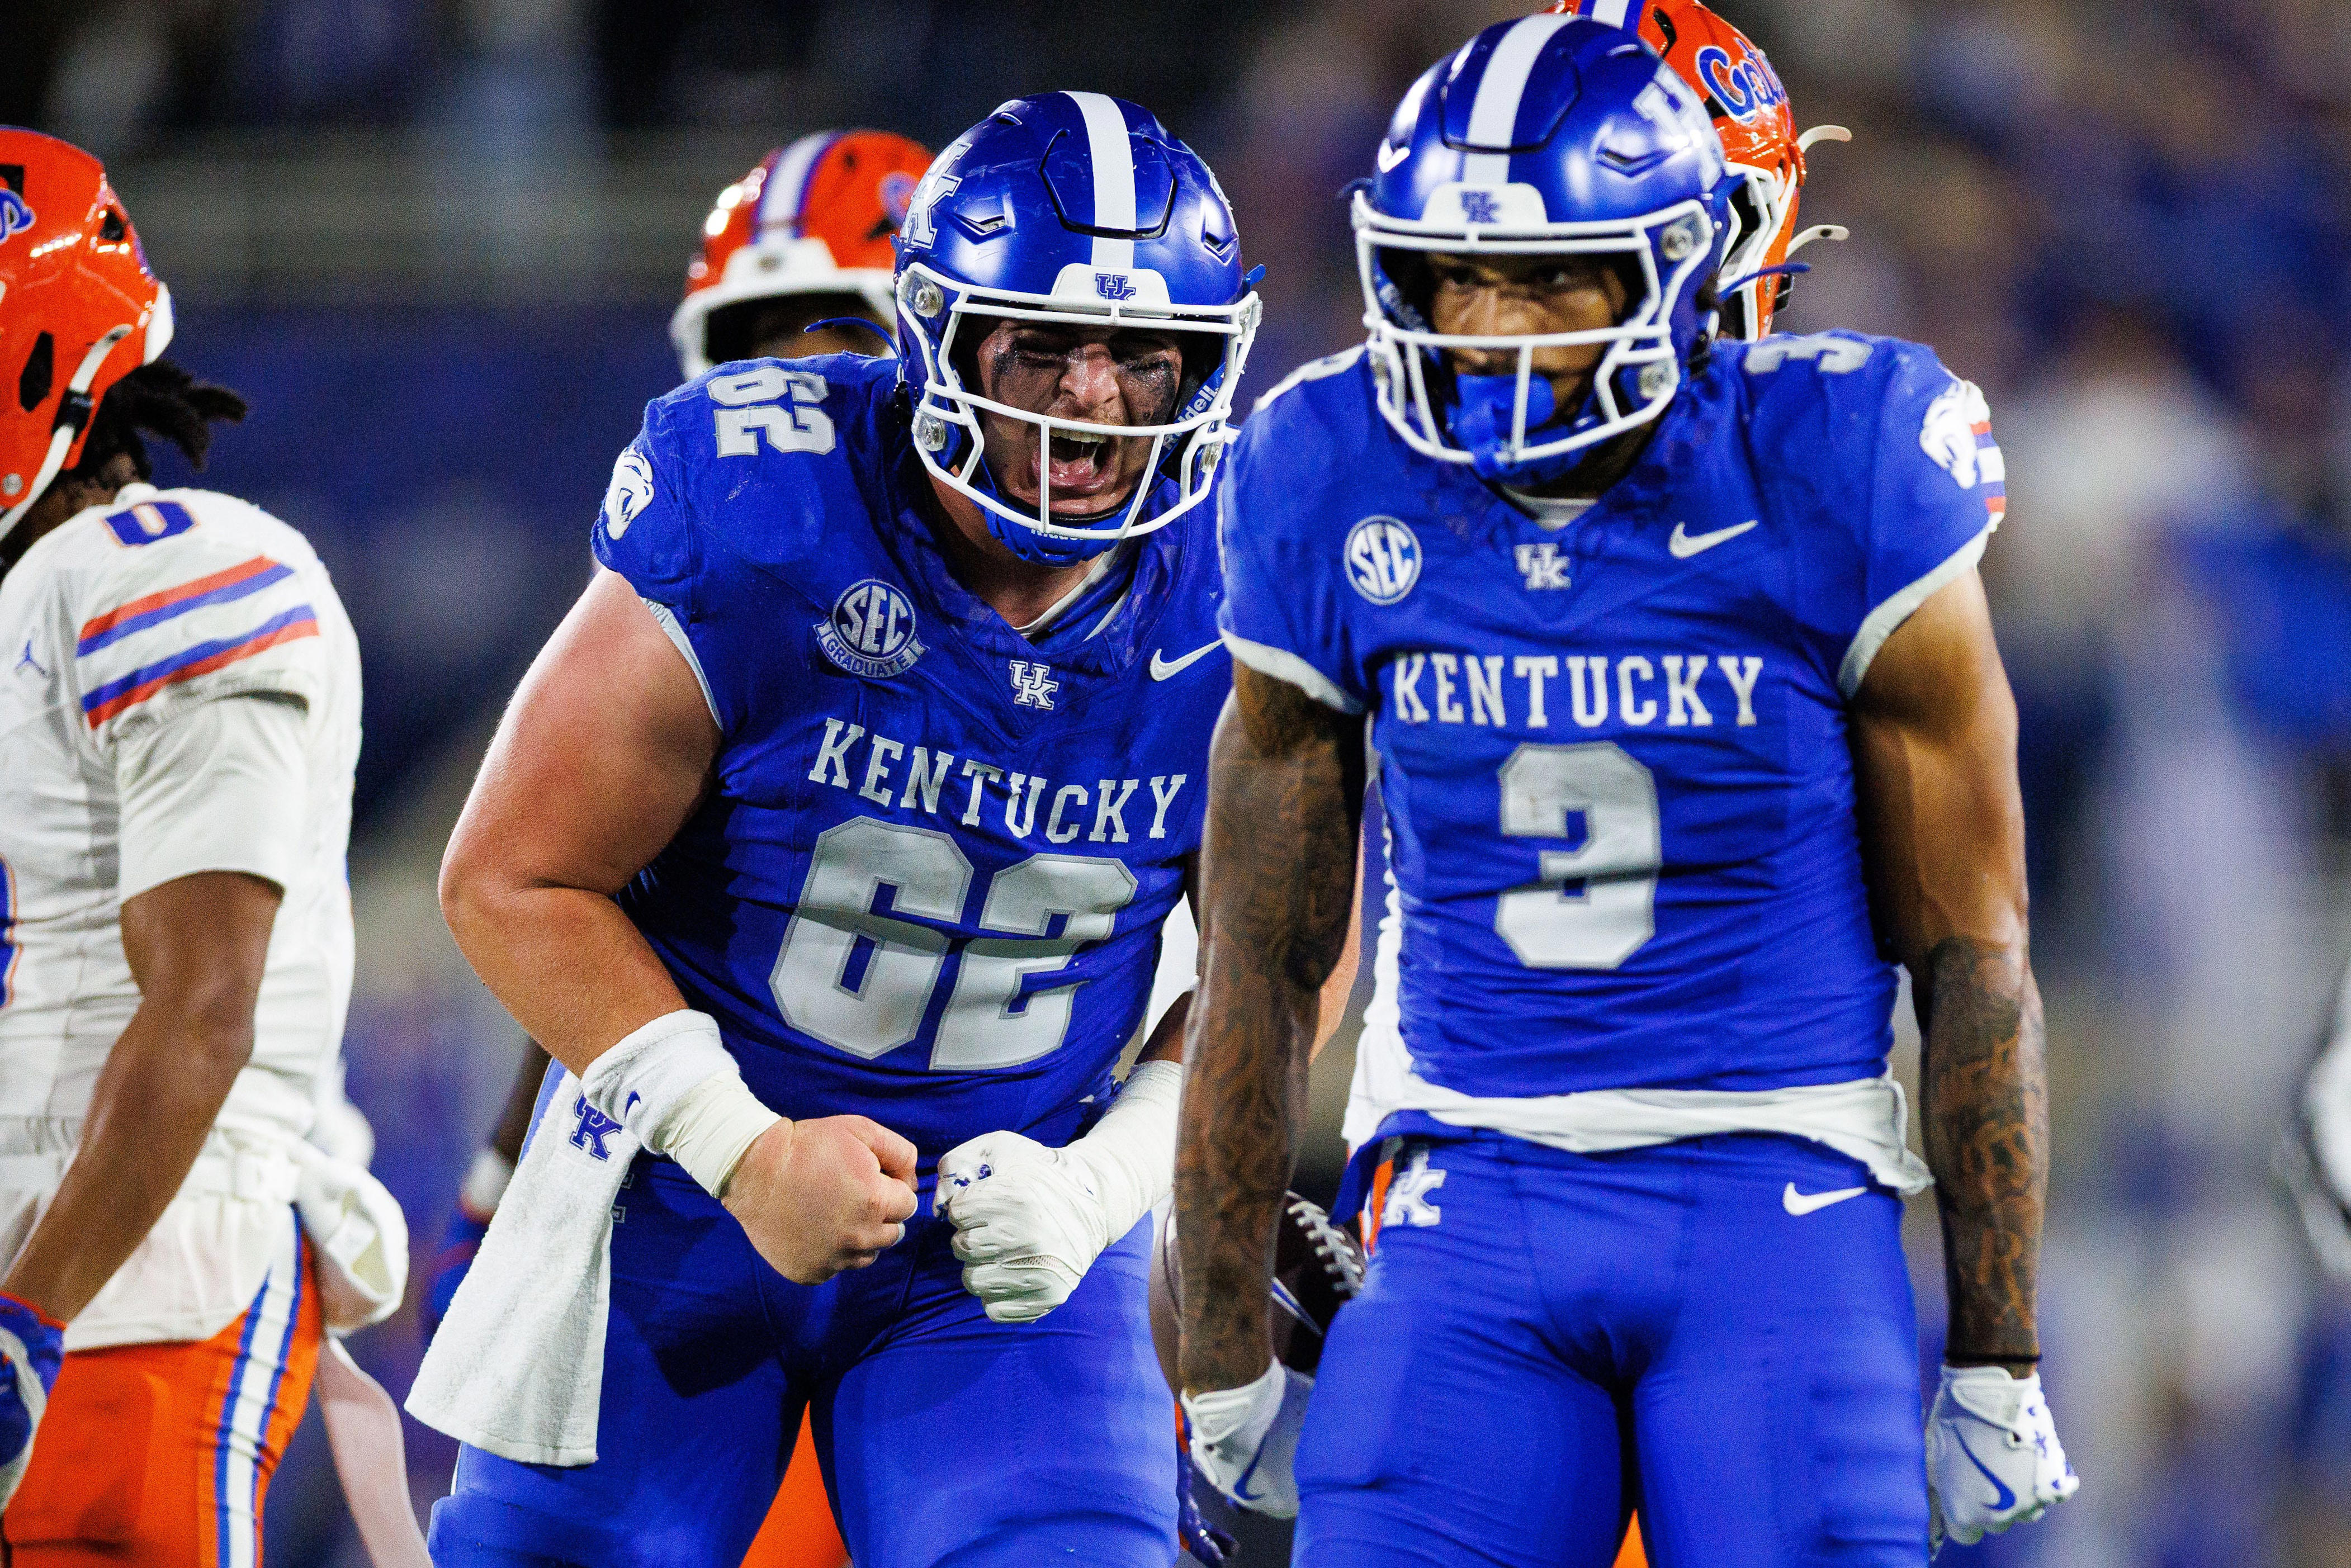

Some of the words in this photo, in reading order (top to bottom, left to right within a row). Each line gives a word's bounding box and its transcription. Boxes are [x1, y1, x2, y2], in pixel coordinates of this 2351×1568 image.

[706, 367, 836, 458] 62
[1350, 524, 1416, 594] SEC
[1515, 543, 1572, 590] UK
[840, 585, 909, 655] SEC
[825, 638, 910, 676] GRADUATE
[1009, 660, 1059, 710] UK
[1393, 652, 1764, 727] KENTUCKY
[808, 717, 1186, 844] KENTUCKY
[1493, 740, 1663, 970] 3
[768, 814, 1139, 1071] 62
